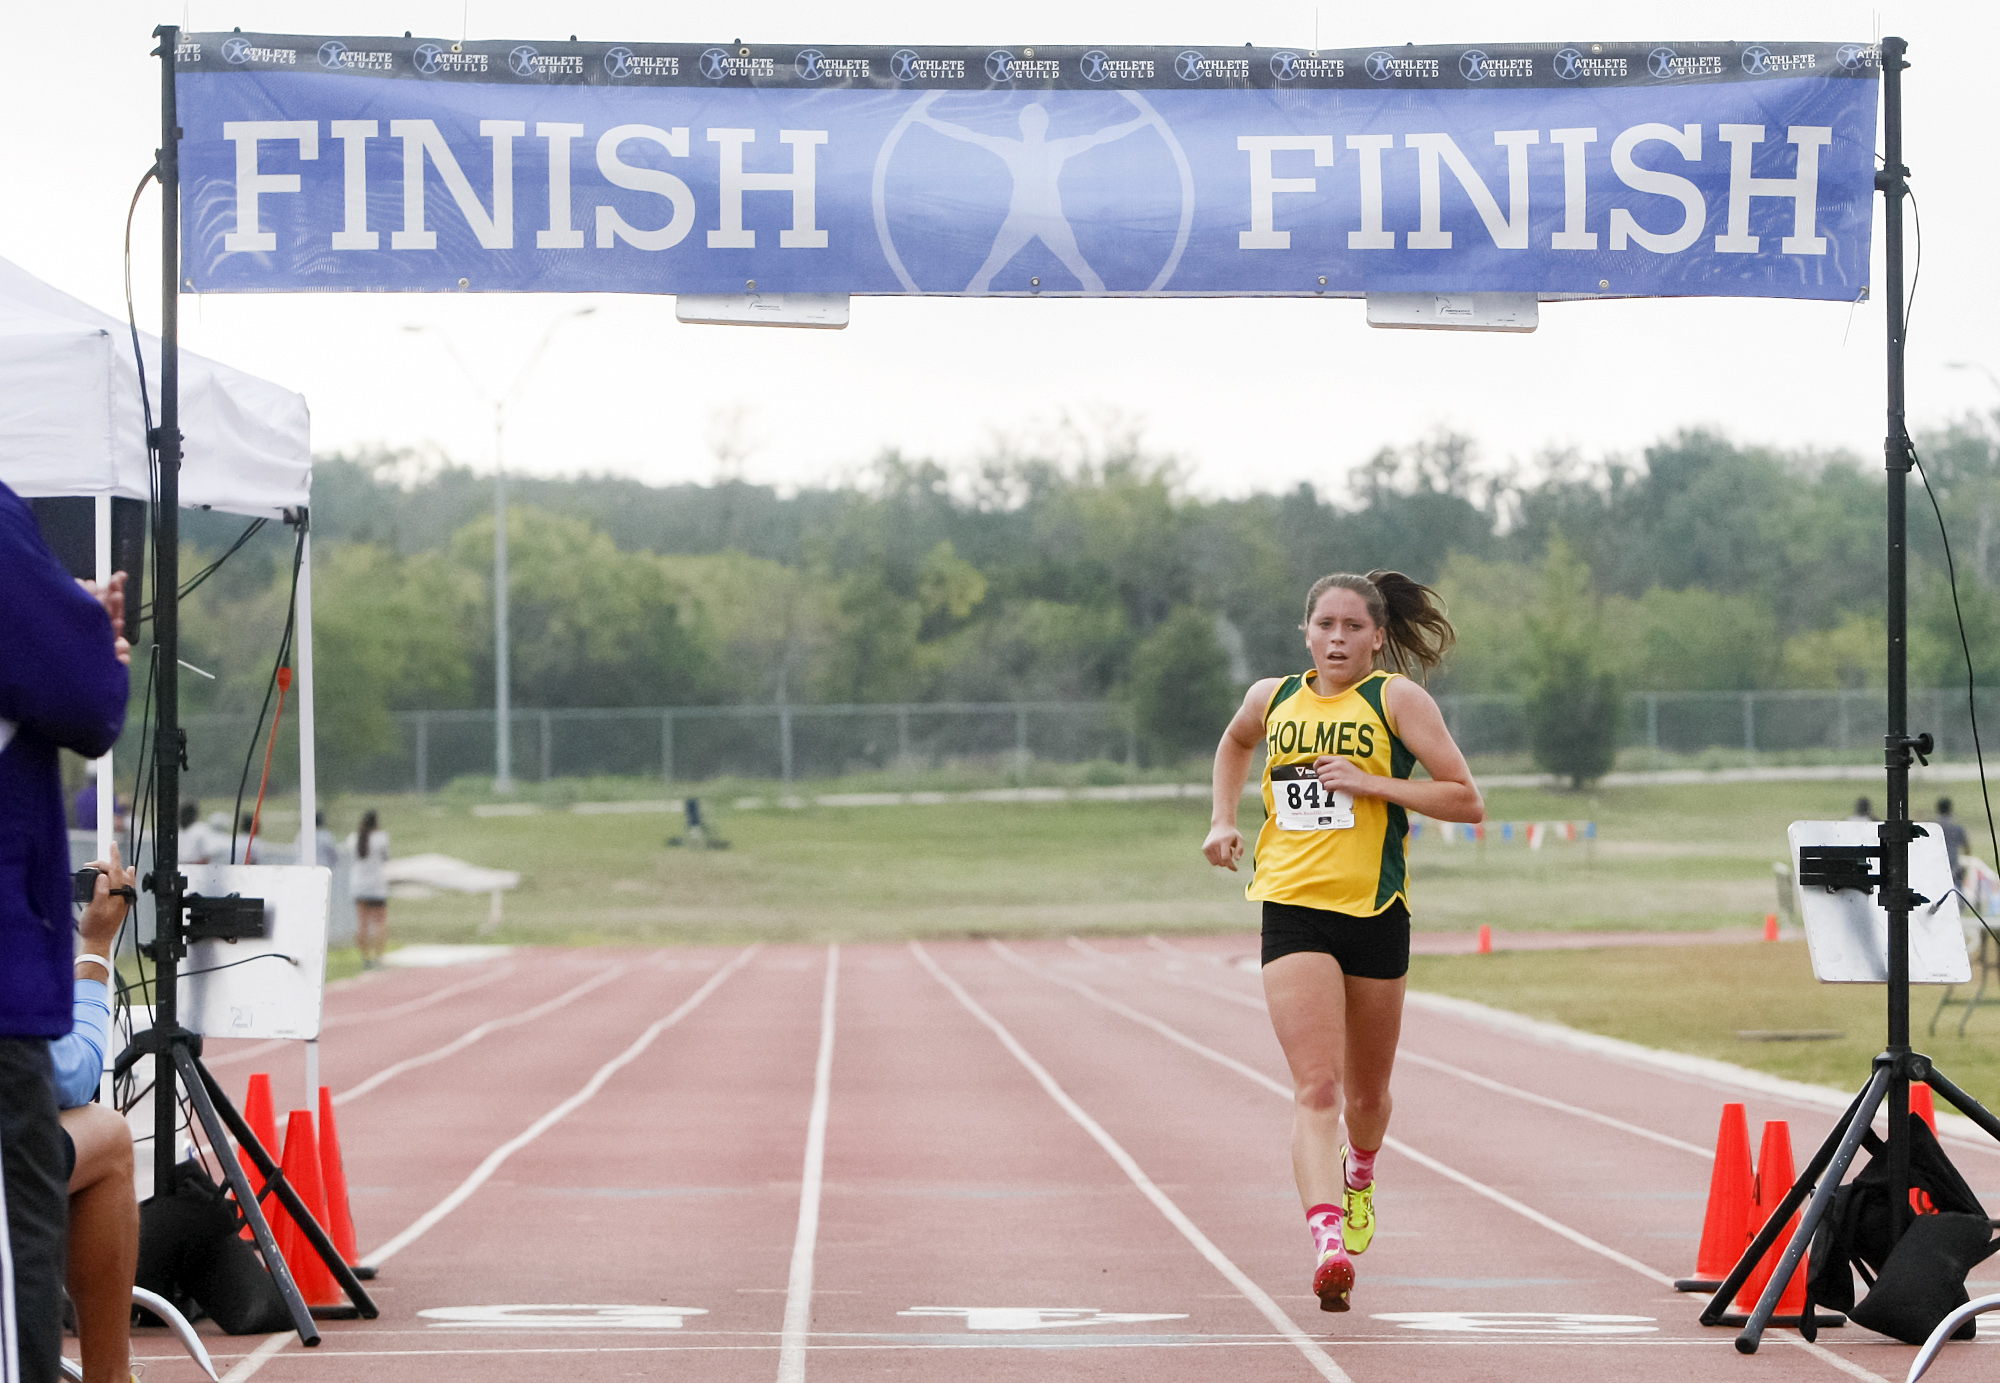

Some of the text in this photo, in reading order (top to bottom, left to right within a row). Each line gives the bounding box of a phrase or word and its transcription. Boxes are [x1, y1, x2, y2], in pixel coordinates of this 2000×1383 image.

[243, 48, 296, 59] ATHLETE
[339, 52, 392, 62] ATHLETE
[434, 54, 488, 64] ATHLETE
[530, 56, 583, 66] ATHLETE
[626, 57, 678, 67] ATHLETE
[721, 58, 773, 68] ATHLETE
[816, 59, 869, 69] ATHLETE
[1480, 59, 1532, 69] ATHLETE
[1574, 58, 1627, 69] ATHLETE
[1669, 57, 1721, 67] ATHLETE
[1762, 54, 1815, 66] ATHLETE
[347, 61, 392, 70] GUILD
[443, 63, 488, 72] GUILD
[538, 65, 583, 74] GUILD
[911, 60, 964, 70] ATHLETE
[1006, 60, 1059, 71] ATHLETE
[1101, 60, 1154, 71] ATHLETE
[1196, 60, 1249, 70] ATHLETE
[1291, 59, 1344, 70] ATHLETE
[1386, 59, 1438, 70] ATHLETE
[1772, 63, 1815, 71] GUILD
[634, 67, 678, 76] GUILD
[730, 68, 773, 77] GUILD
[825, 69, 869, 78] GUILD
[920, 70, 964, 79] GUILD
[1015, 70, 1059, 79] GUILD
[1109, 70, 1154, 79] GUILD
[1205, 69, 1249, 78] GUILD
[1300, 69, 1344, 78] GUILD
[1395, 69, 1438, 78] GUILD
[1489, 69, 1532, 77] GUILD
[1583, 68, 1627, 77] GUILD
[1678, 66, 1722, 75] GUILD
[223, 118, 829, 251] FINISH
[1237, 122, 1833, 255] FINISH
[1268, 720, 1375, 758] HOLMES
